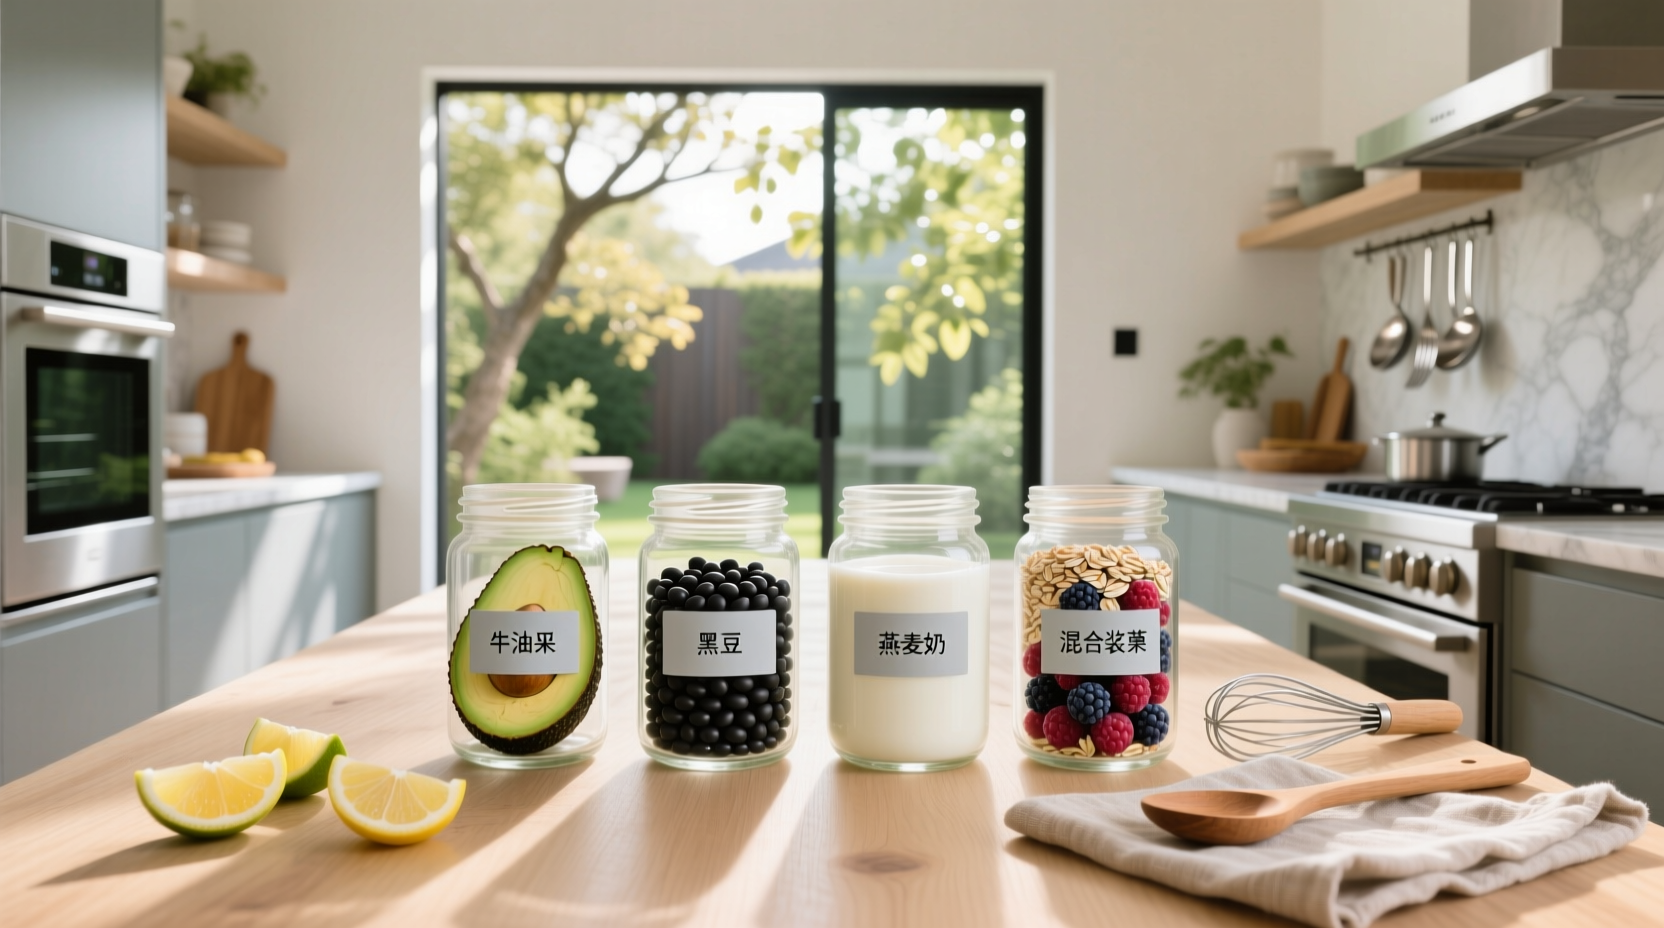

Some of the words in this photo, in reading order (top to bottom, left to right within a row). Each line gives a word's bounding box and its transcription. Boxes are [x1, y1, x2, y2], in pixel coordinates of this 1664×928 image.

[697, 632, 743, 656] 黑豆
[878, 630, 946, 656] 燕麦奶
